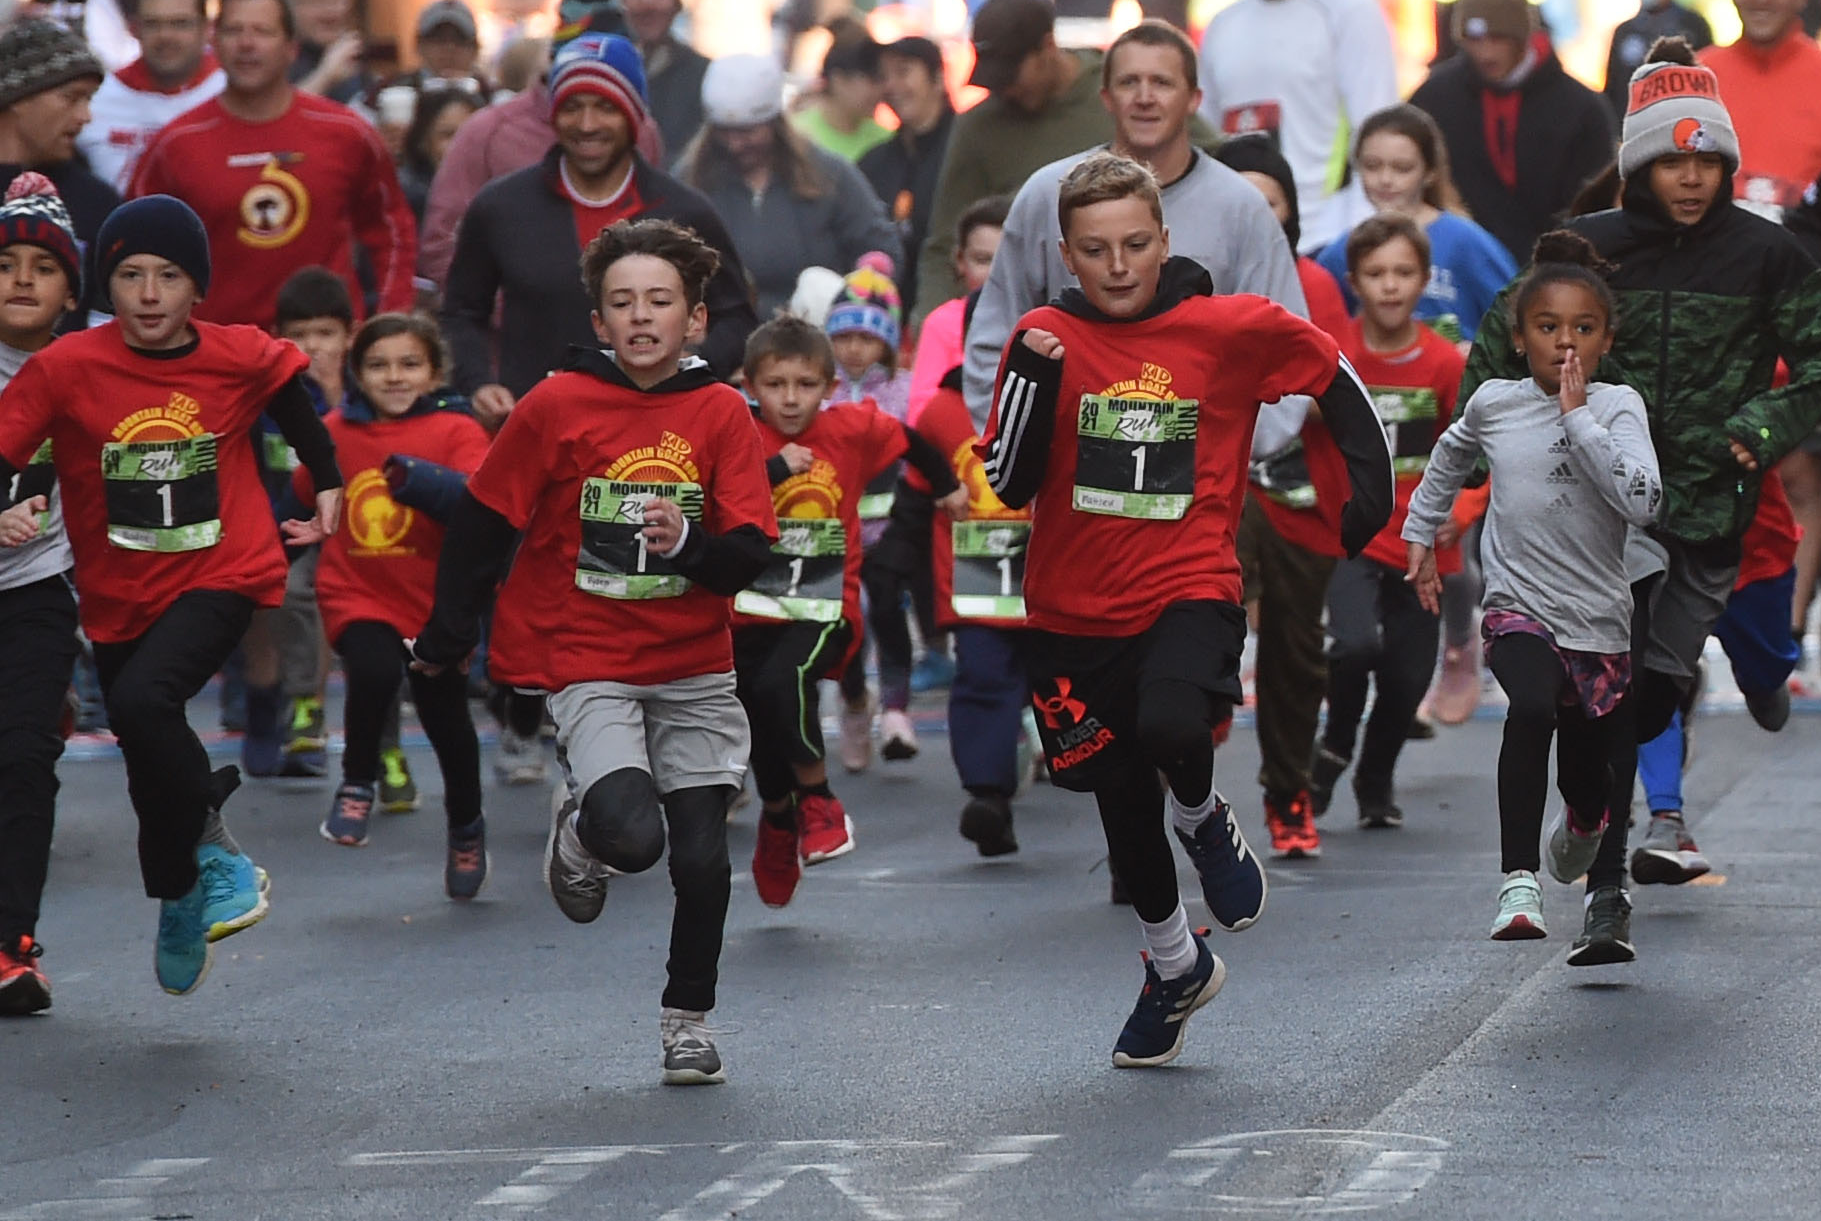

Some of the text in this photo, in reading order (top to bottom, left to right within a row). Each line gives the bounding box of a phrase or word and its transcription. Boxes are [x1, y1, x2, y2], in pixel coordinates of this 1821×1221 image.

[1141, 362, 1173, 385] KID
[1082, 400, 1099, 417] 20
[1107, 398, 1175, 414] MOUNTAIN
[1081, 416, 1098, 431] 21
[1109, 414, 1162, 440] Run
[1176, 406, 1199, 442] RUN
[127, 439, 192, 454] MOUNTAIN
[660, 430, 693, 455] KID
[604, 446, 656, 480] MOUNTAIN
[1131, 445, 1147, 491] 1
[583, 484, 601, 500] 20
[609, 482, 678, 497] MOUNTAIN
[156, 483, 173, 527] 1
[583, 499, 600, 514] 21
[634, 531, 648, 573] 1
[788, 557, 804, 597] 1
[996, 556, 1012, 596] 1
[1052, 727, 1116, 772] ARMOUR
